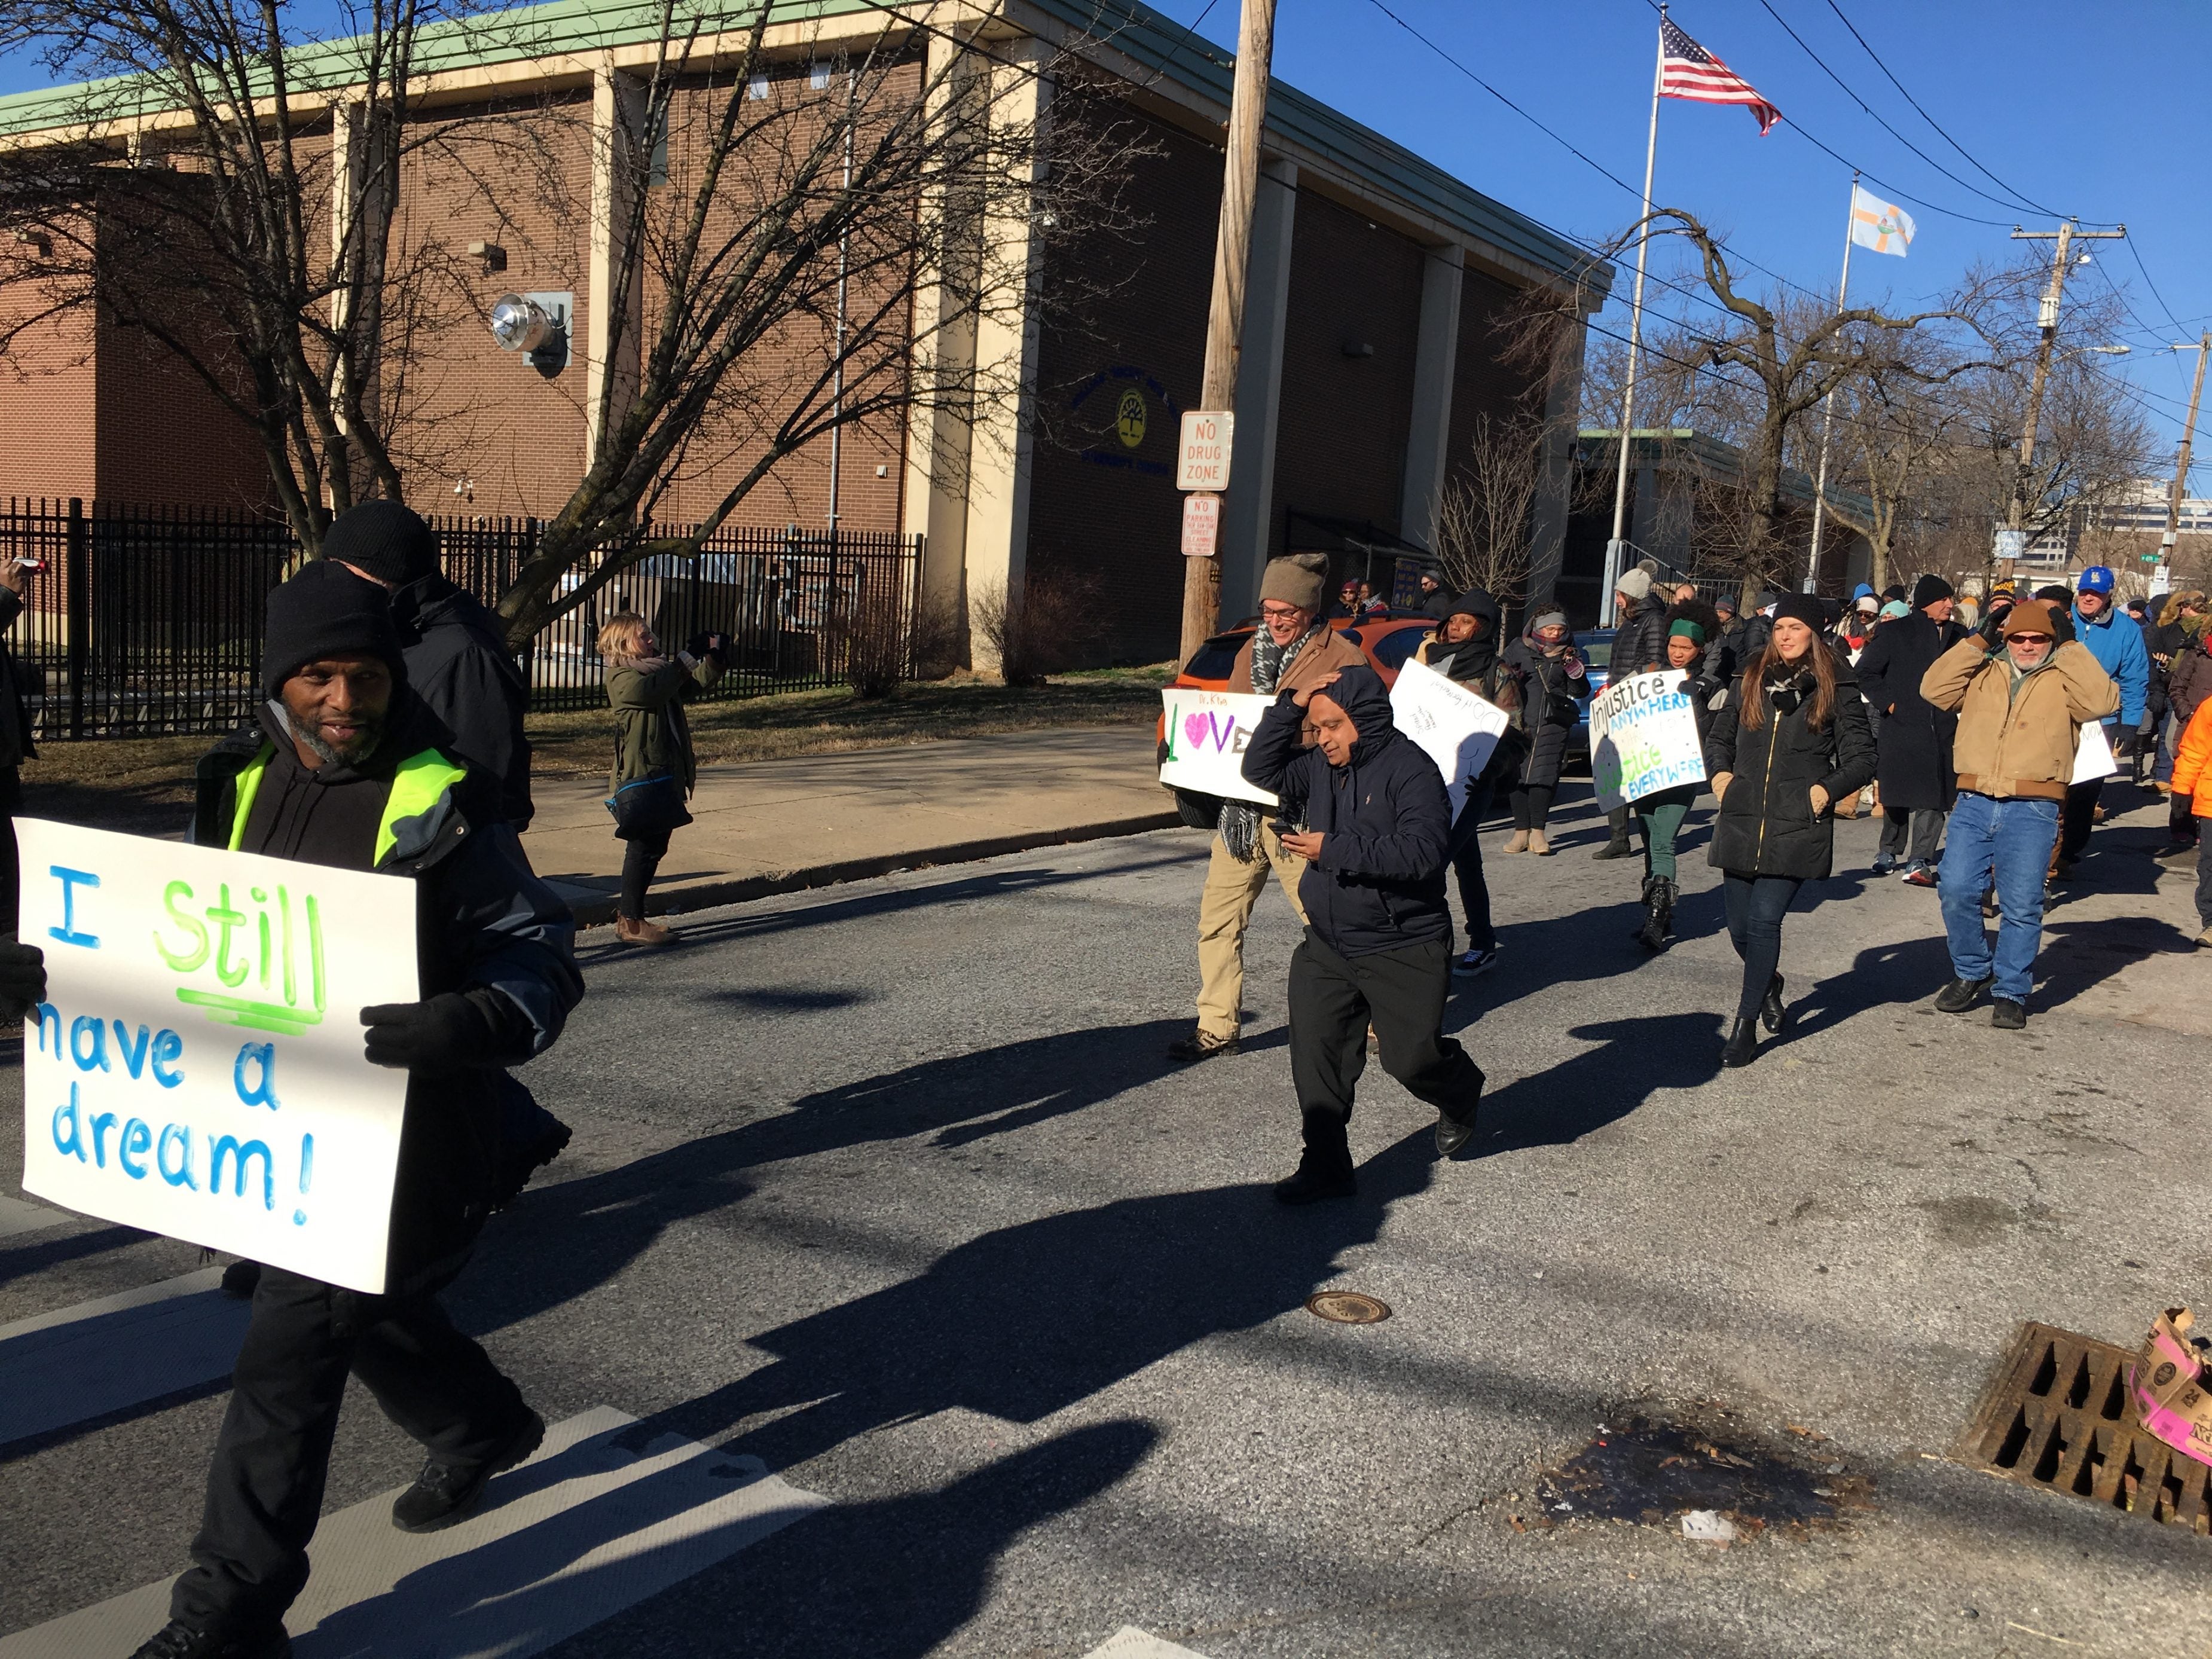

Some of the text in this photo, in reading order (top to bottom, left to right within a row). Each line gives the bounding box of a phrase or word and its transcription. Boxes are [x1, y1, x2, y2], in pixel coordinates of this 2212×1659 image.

[1187, 446, 1221, 460] DRUG
[1196, 423, 1216, 440] NO
[1187, 466, 1219, 479] ZONE
[1194, 502, 1208, 512] NO
[1591, 674, 1666, 737] Injustice
[1610, 692, 1691, 735] ANYWHERE
[50, 864, 326, 1013] I Still
[234, 1042, 281, 1111] a
[52, 1081, 314, 1226] dream!
